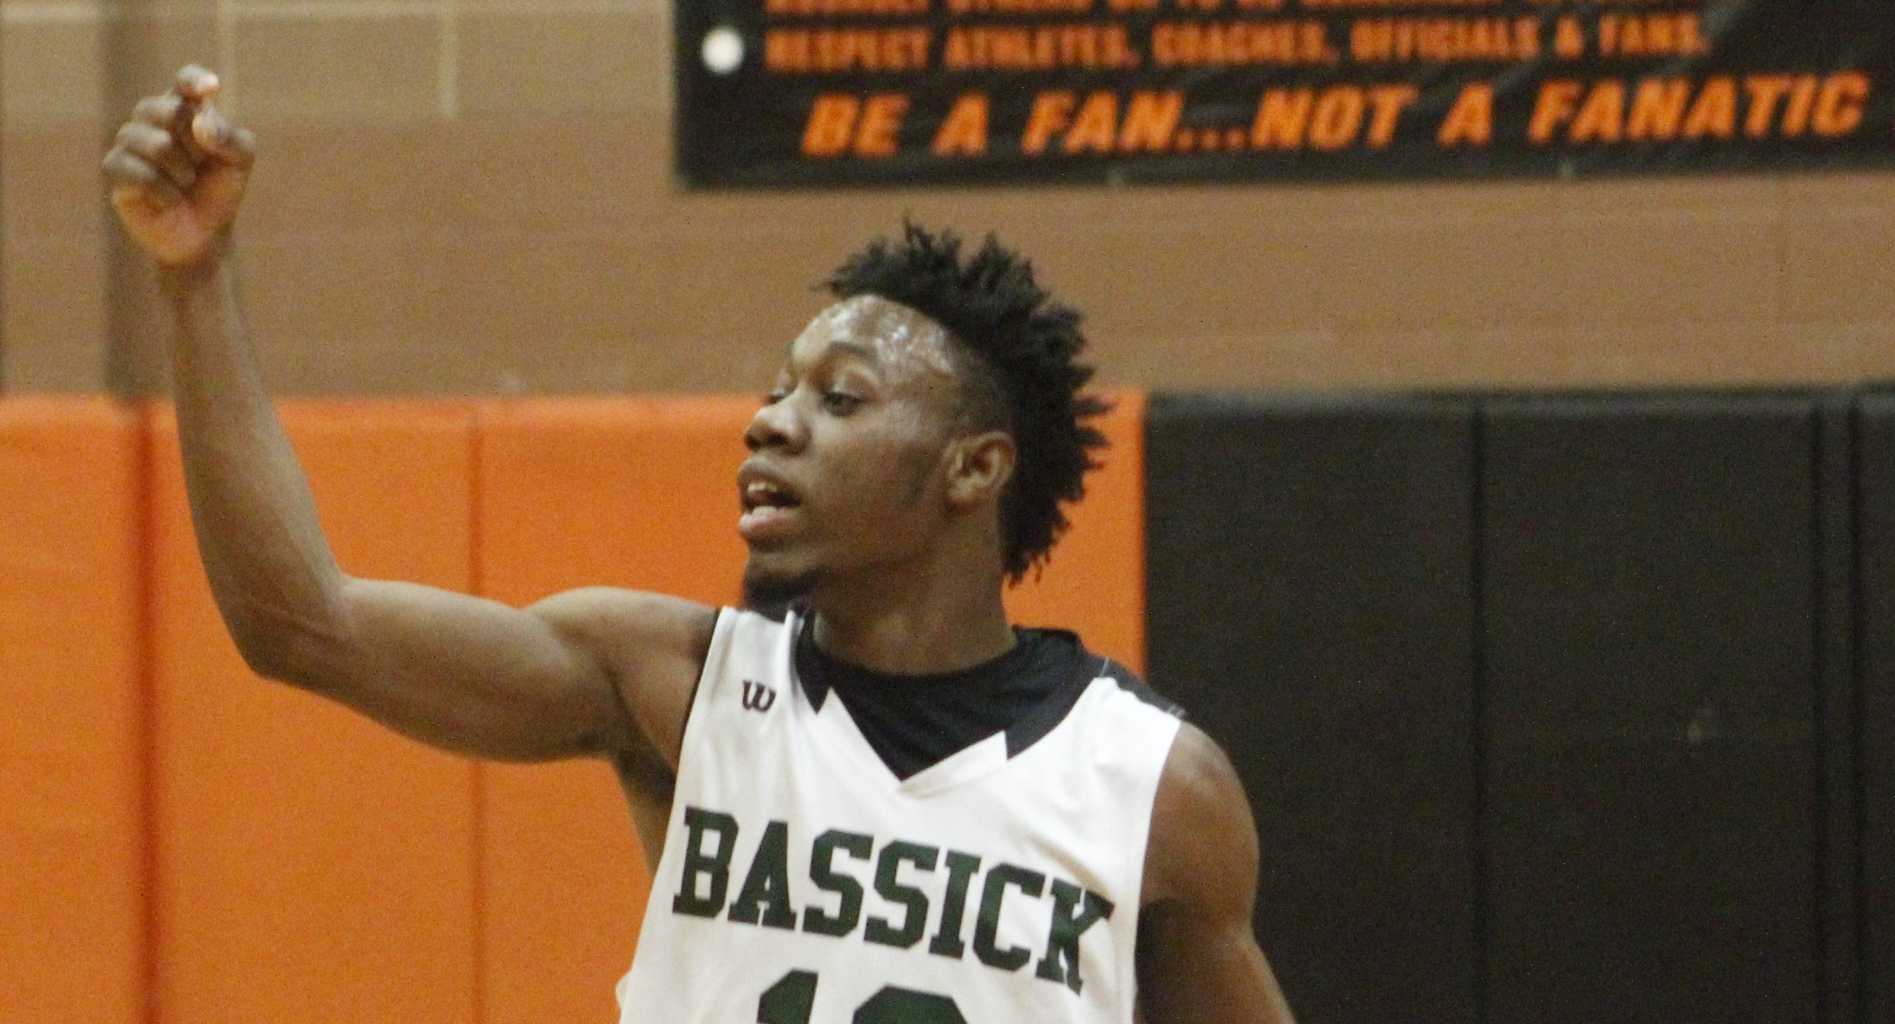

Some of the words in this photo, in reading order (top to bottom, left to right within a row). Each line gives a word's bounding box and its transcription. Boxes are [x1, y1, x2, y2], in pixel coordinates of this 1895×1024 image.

[765, 27, 932, 71] RESPECT
[1349, 15, 1540, 61] OFFICIALS
[801, 92, 910, 156] BE
[932, 92, 990, 156] A
[1437, 82, 1495, 147] A
[1527, 70, 1870, 145] FANATIC
[673, 806, 1115, 994] BASSICK
